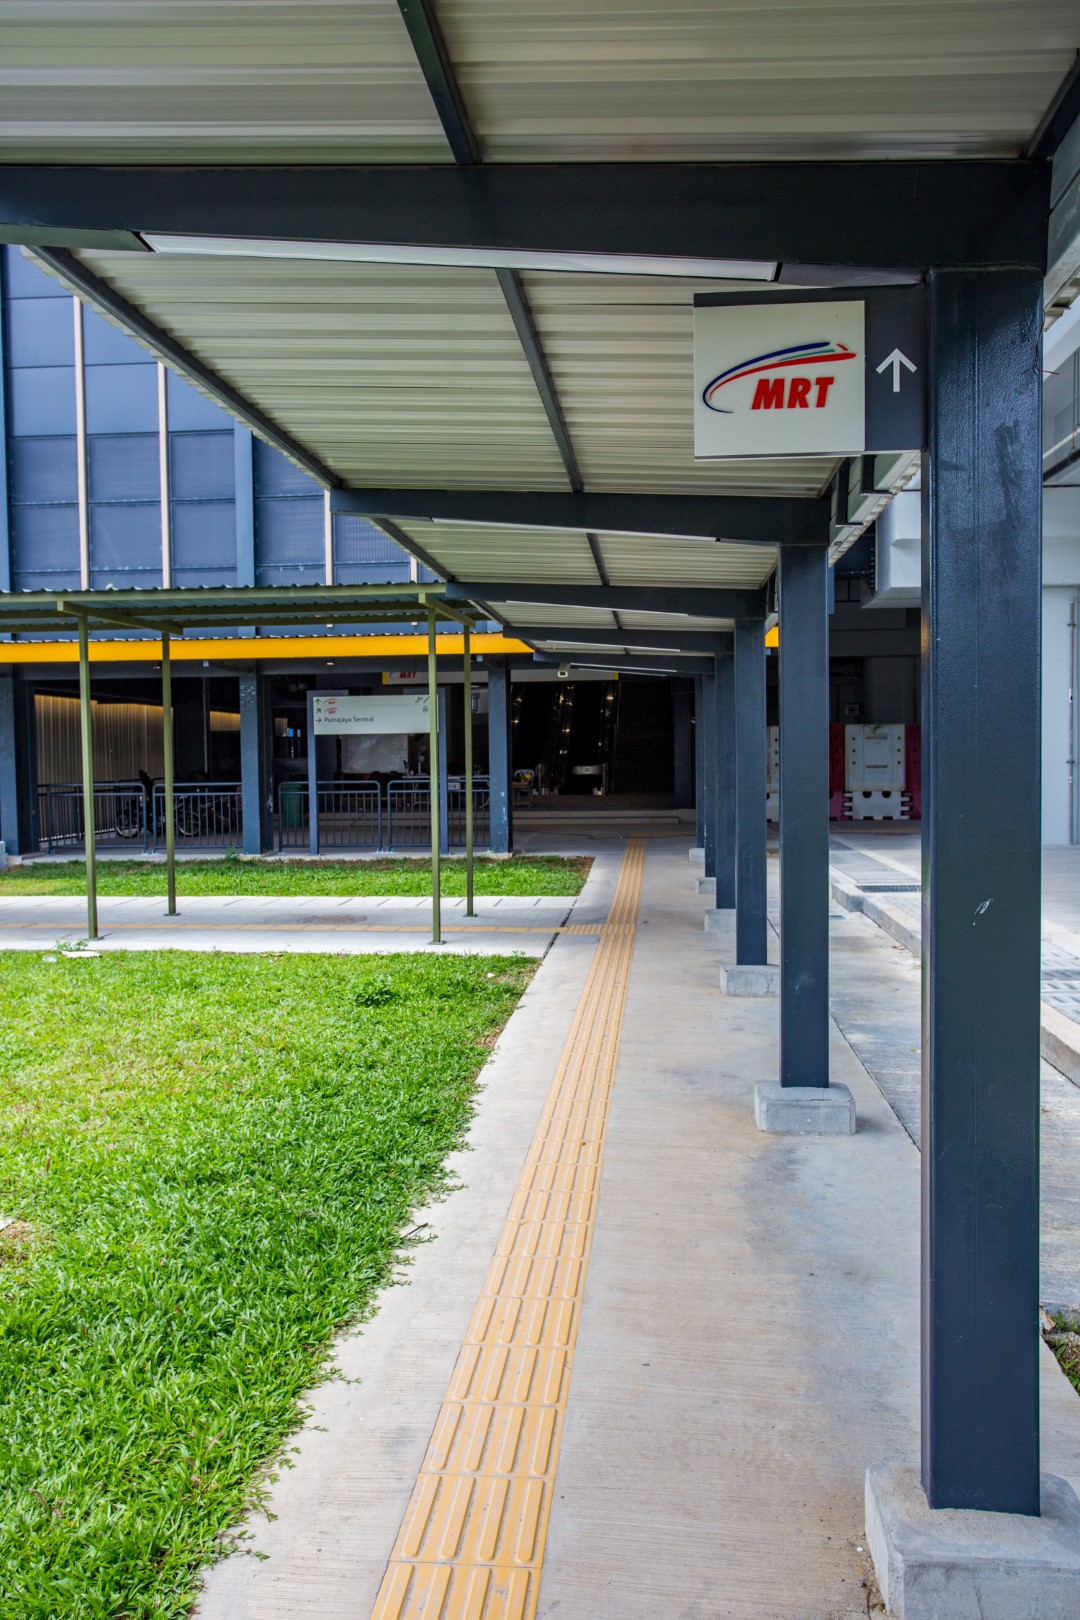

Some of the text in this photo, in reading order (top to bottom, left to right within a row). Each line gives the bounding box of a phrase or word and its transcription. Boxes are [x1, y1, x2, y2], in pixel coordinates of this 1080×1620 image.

[751, 376, 835, 411] MRT
[399, 671, 417, 679] MRT
[324, 716, 352, 724] Putrajaya
